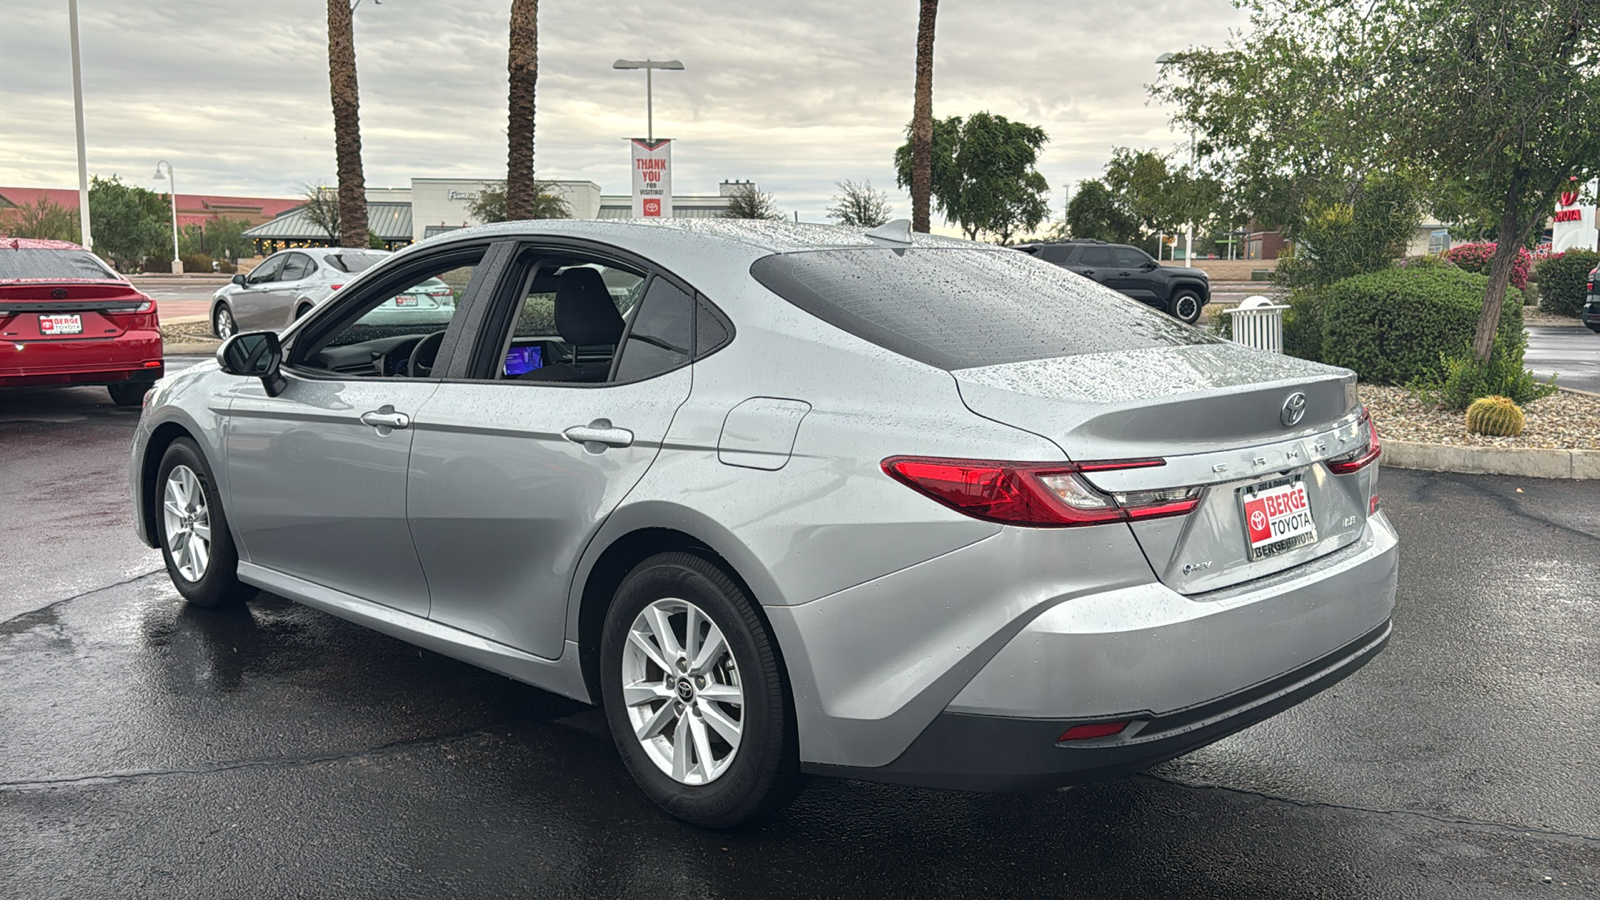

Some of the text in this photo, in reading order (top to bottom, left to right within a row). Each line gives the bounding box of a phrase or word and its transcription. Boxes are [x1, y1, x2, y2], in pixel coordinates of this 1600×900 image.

[636, 158, 667, 170] THANK
[642, 170, 661, 182] YOU
[54, 318, 79, 326] BERGE
[1265, 488, 1306, 518] BERGE
[1271, 511, 1311, 537] TOYOTA
